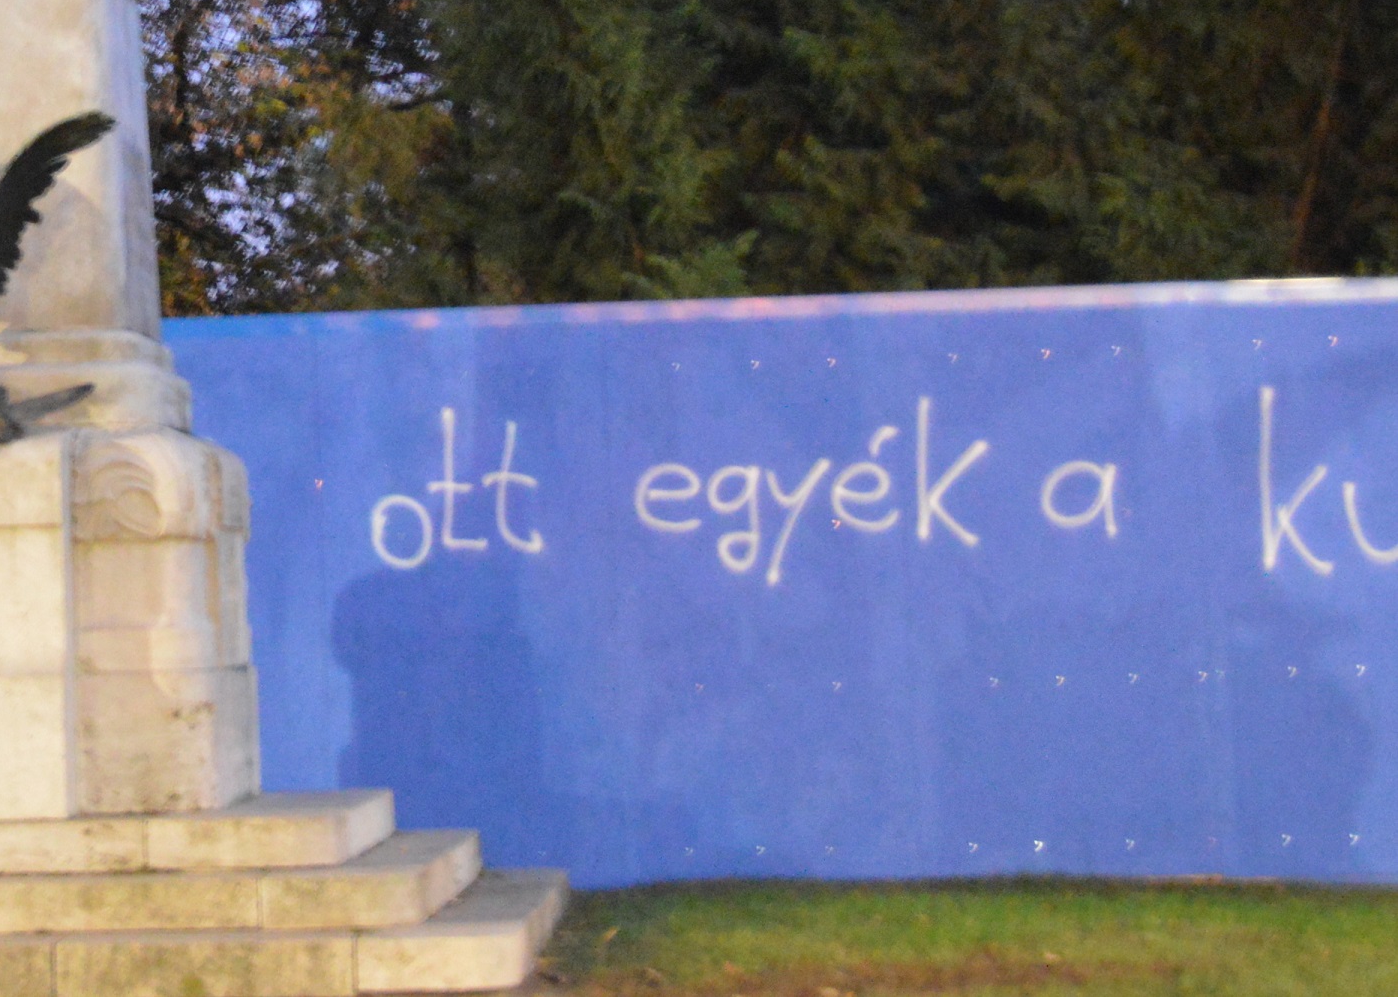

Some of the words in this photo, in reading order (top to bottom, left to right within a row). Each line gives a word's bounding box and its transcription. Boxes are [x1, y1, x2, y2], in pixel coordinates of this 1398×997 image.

[370, 407, 544, 568] ott
[634, 396, 991, 586] egyék
[1041, 460, 1118, 539] a
